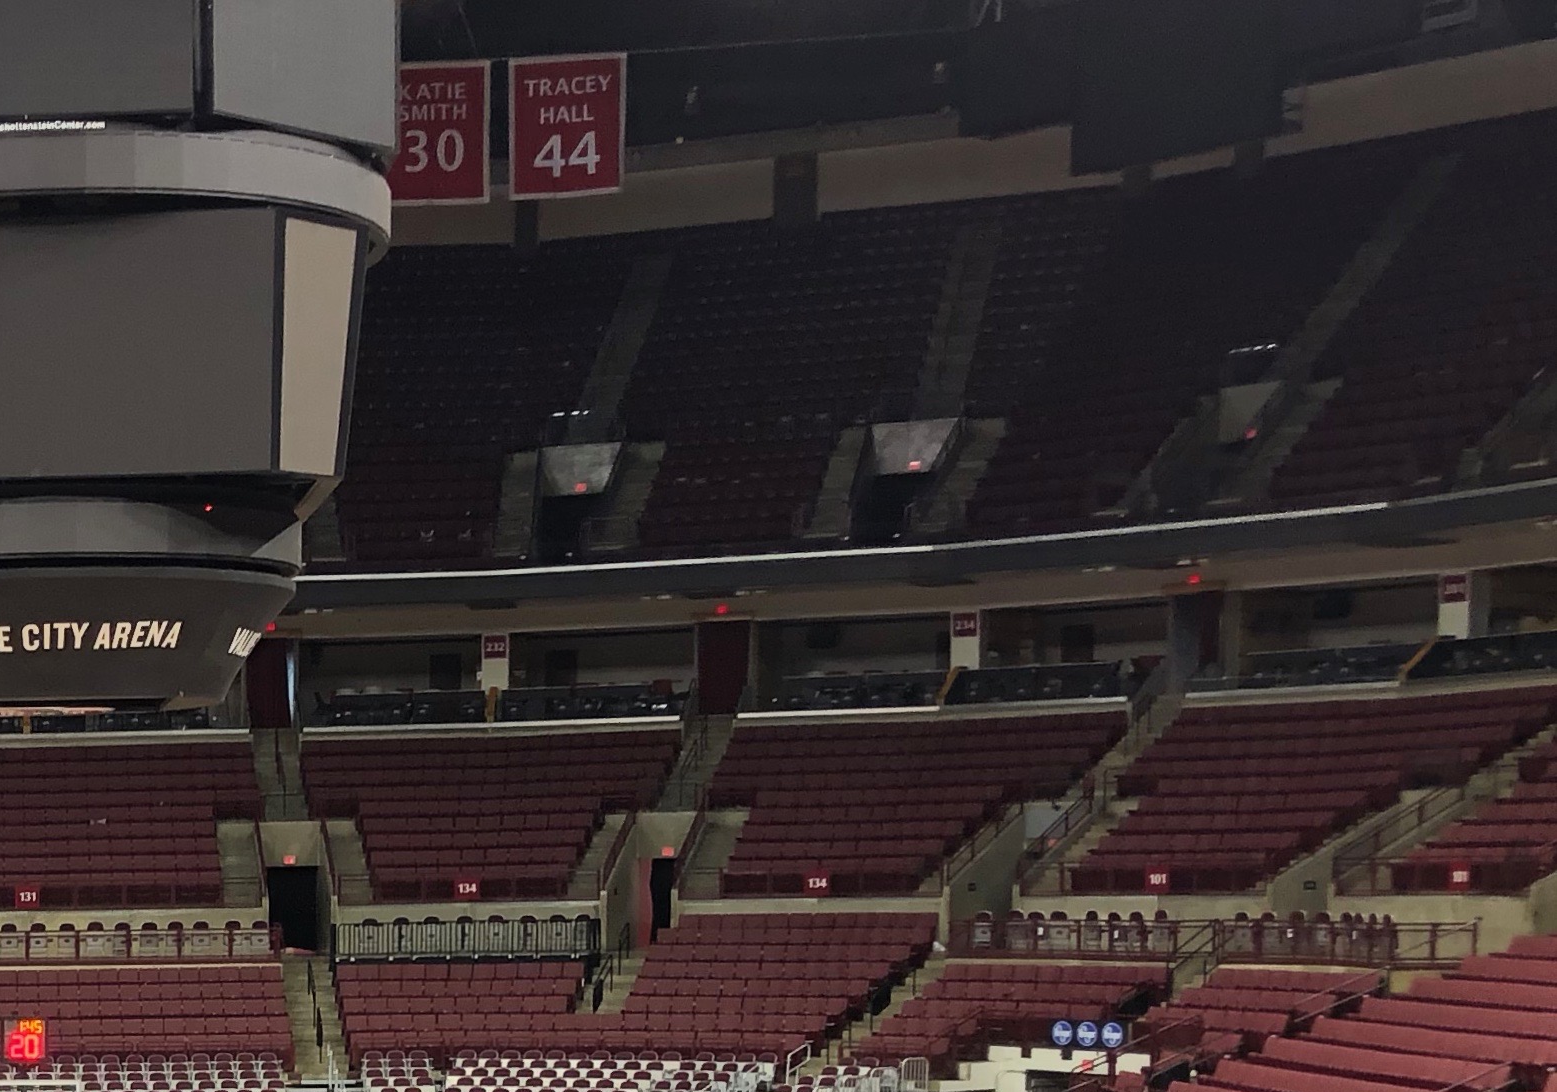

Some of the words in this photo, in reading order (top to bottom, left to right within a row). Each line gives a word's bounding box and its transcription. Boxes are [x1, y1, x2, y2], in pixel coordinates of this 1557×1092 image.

[400, 82, 467, 100] KATIE
[524, 74, 611, 98] TRACEY
[400, 103, 467, 122] SMITH
[539, 104, 595, 125] HALL
[405, 129, 465, 173] 30
[533, 130, 600, 178] 44
[21, 622, 91, 652] CITY
[94, 620, 184, 650] ARENA
[458, 883, 477, 894] 134
[808, 877, 828, 889] 134
[1149, 873, 1166, 885] 101
[19, 891, 37, 902] 131
[19, 1020, 42, 1034] 1:45
[11, 1033, 39, 1059] 20
